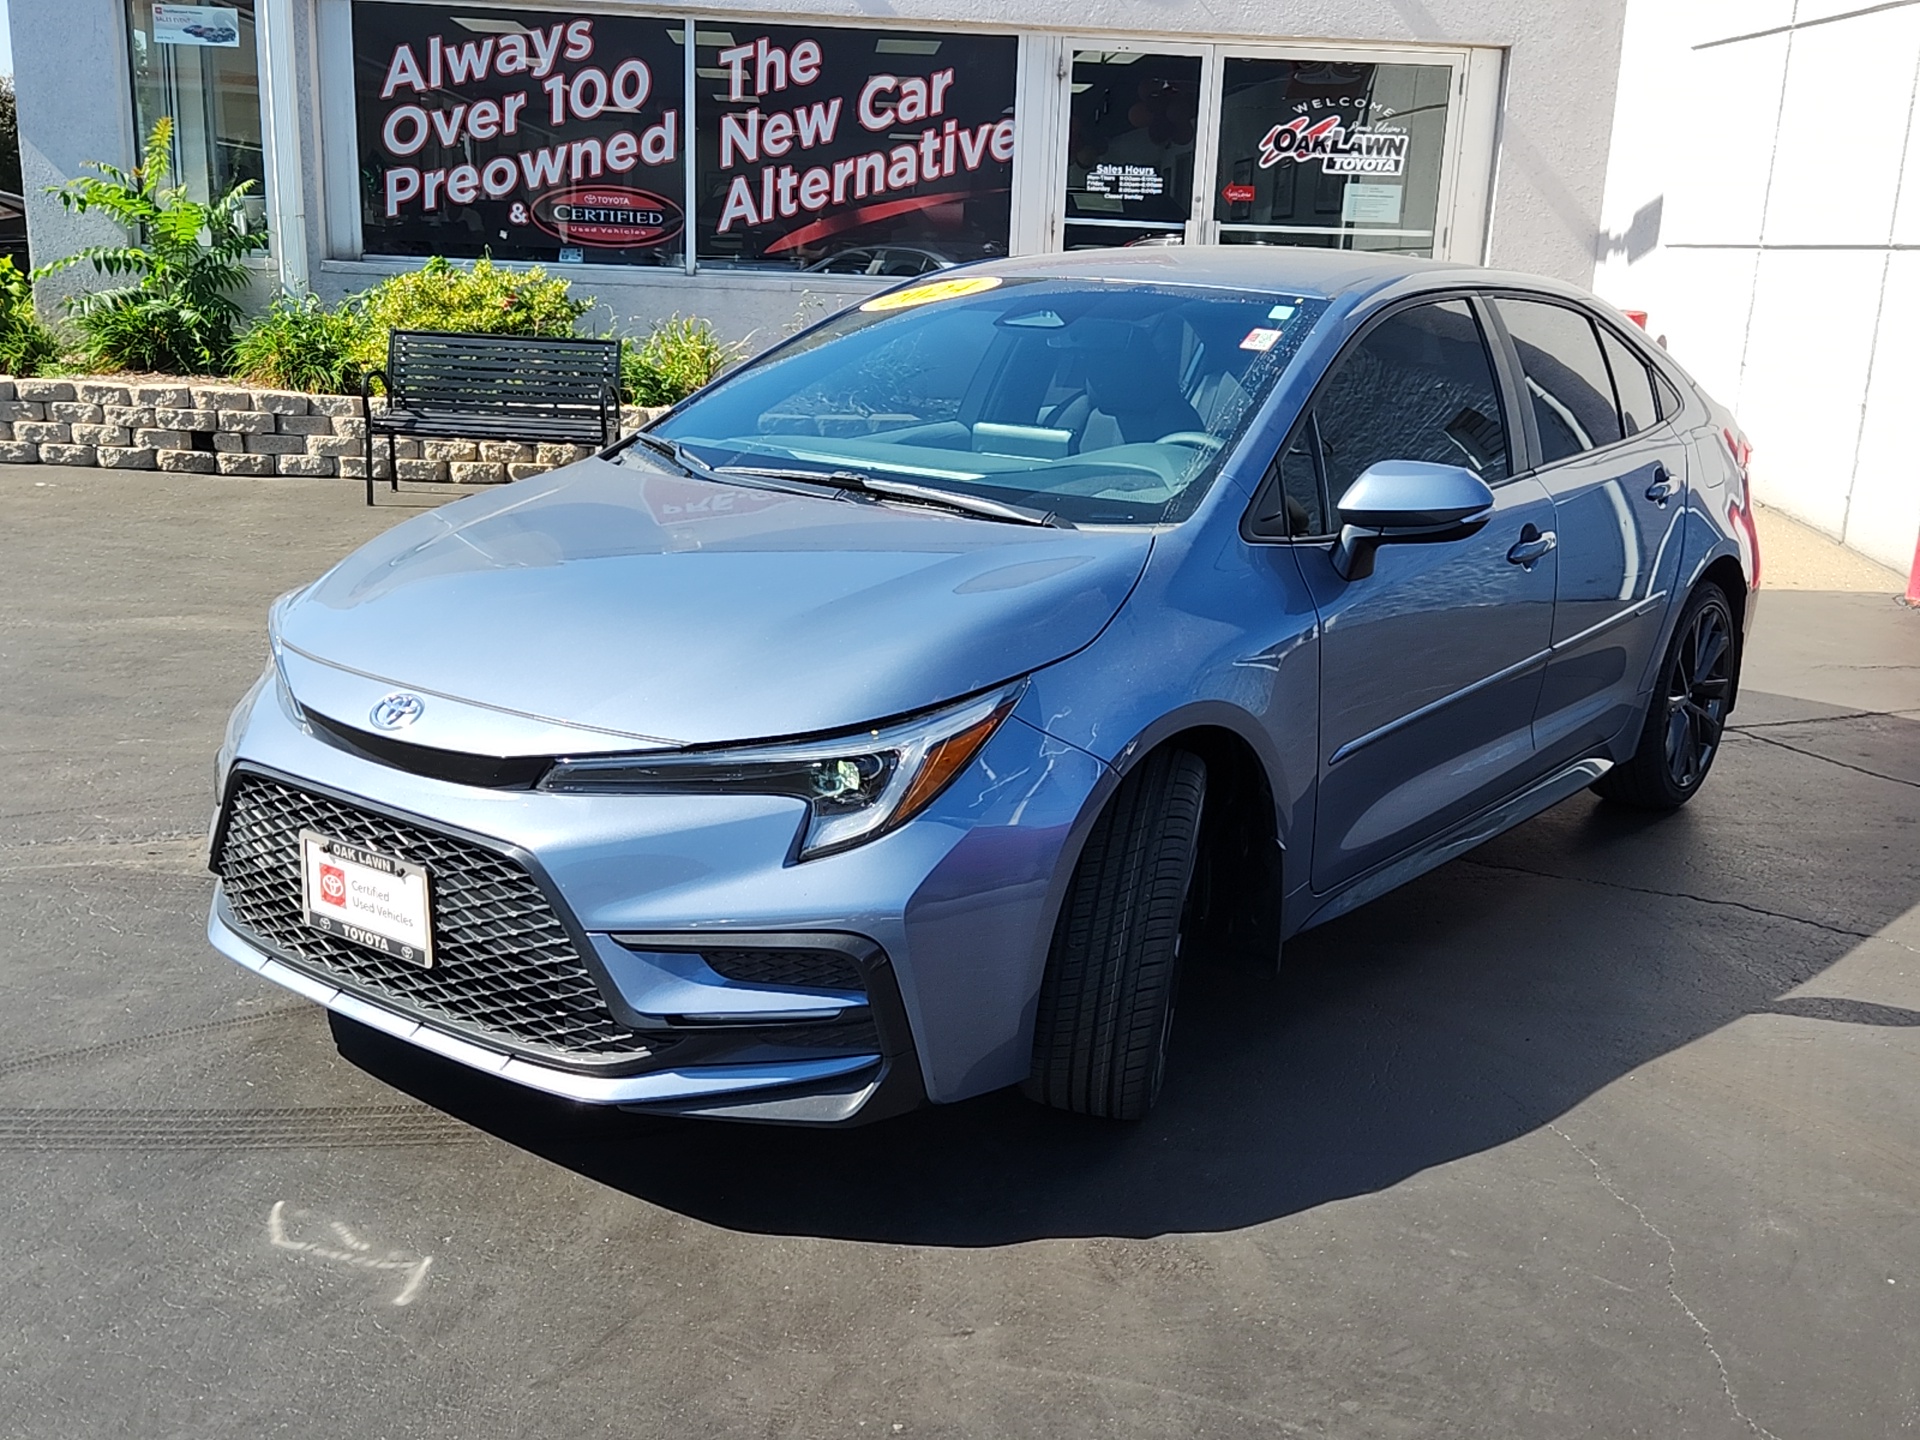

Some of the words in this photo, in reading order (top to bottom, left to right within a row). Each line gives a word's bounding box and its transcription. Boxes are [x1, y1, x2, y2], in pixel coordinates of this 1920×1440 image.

[380, 18, 593, 99] Always
[718, 37, 822, 102] The
[382, 92, 527, 156] Over
[542, 58, 652, 126] 100
[720, 97, 843, 169] New
[858, 67, 955, 131] Car
[1292, 97, 1396, 118] WELCOME
[385, 109, 678, 218] Preowned
[717, 119, 1016, 234] Alternative
[1096, 163, 1123, 174] Sales
[1125, 165, 1155, 175] Hours
[1333, 158, 1396, 172] TOYOTA
[509, 201, 530, 225] &
[553, 204, 664, 225] CERTIFIED
[597, 196, 631, 206] TOYOTA
[570, 225, 598, 234] Used
[600, 226, 648, 236] Vehicles
[332, 843, 357, 861] OAK
[358, 851, 392, 872] LAWN
[351, 880, 390, 903] Certified
[352, 896, 375, 914] Used
[376, 902, 414, 928] Vehicles
[341, 923, 390, 951] TOYOTA
